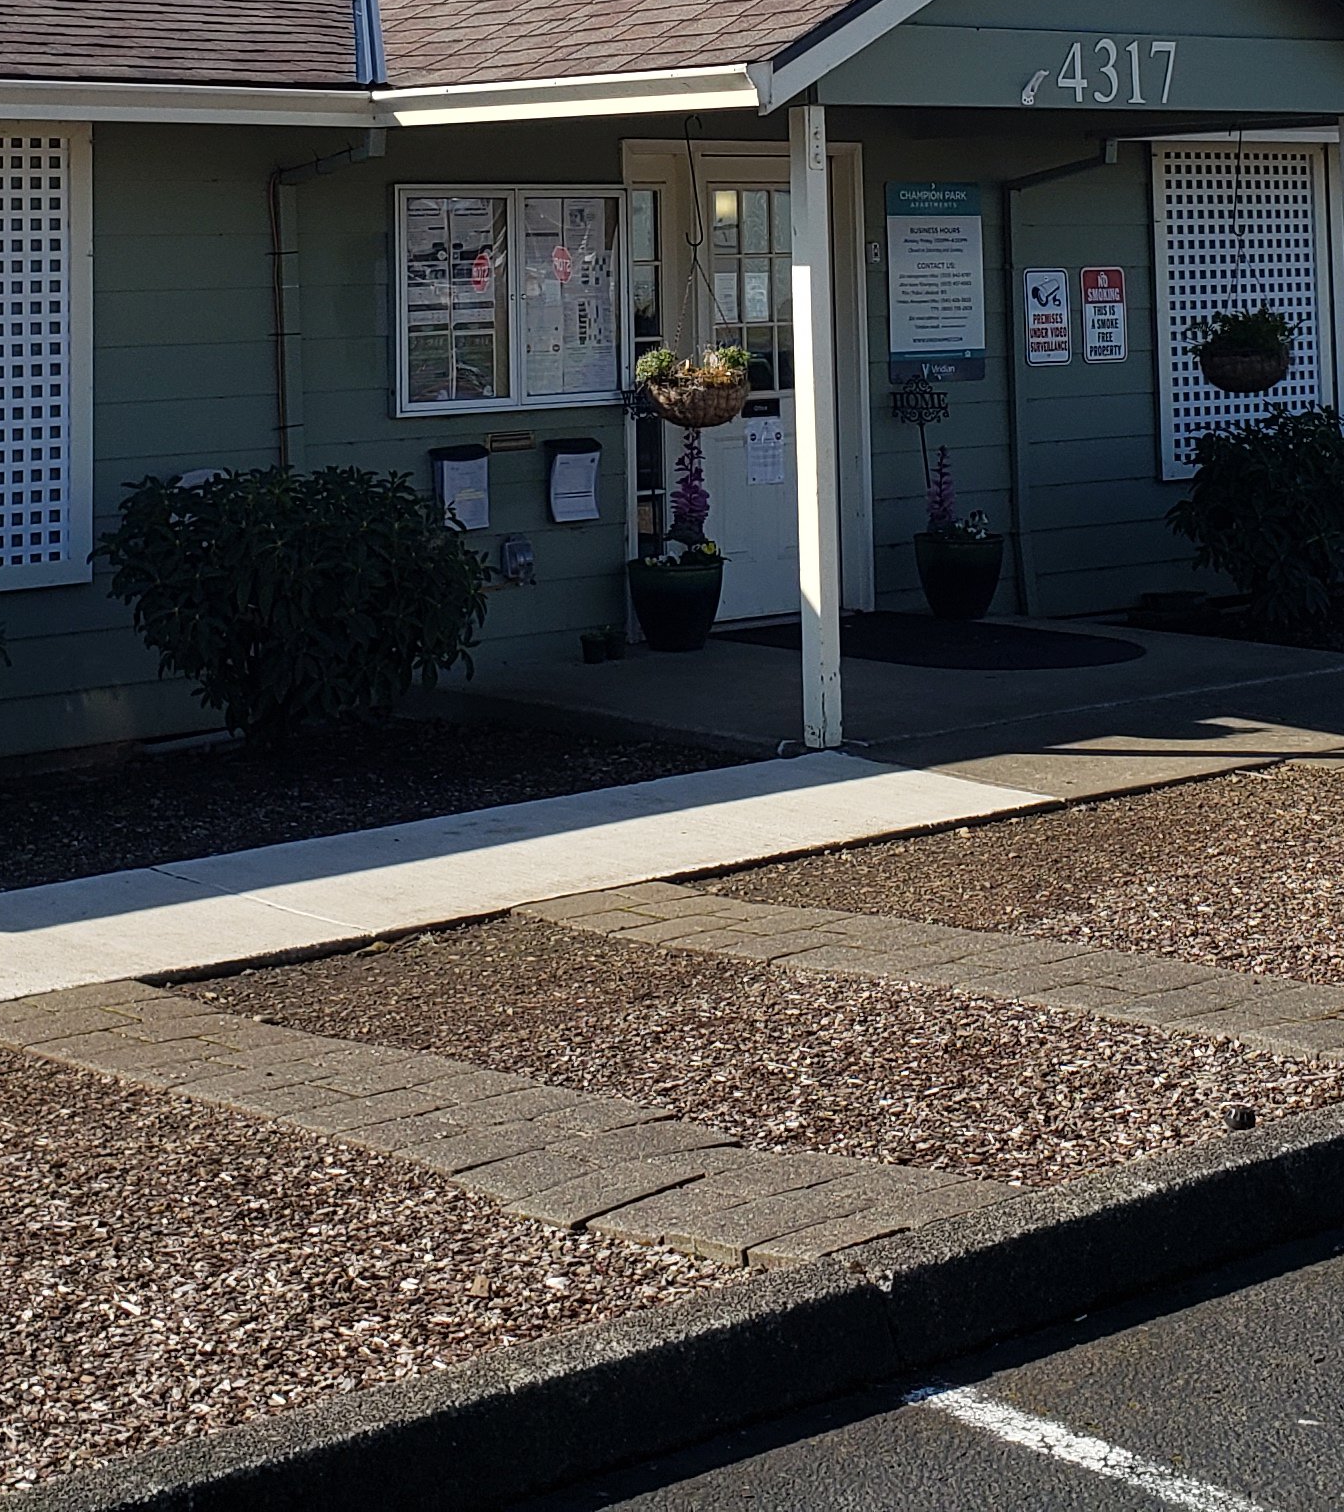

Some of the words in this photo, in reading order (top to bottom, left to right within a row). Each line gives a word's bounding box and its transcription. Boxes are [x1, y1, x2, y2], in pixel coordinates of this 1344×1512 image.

[1057, 38, 1177, 104] 4317
[899, 190, 943, 200] CHAMPION
[944, 191, 967, 200] PARK
[1097, 275, 1109, 287] NO
[1087, 288, 1120, 301] SMOKING
[1093, 305, 1107, 316] THIS
[1108, 305, 1116, 316] IS
[1032, 313, 1063, 325] PREMISES
[1091, 318, 1096, 329] A
[1096, 318, 1119, 329] SMOKE
[1030, 327, 1049, 338] UNDER
[1050, 326, 1067, 338] VIDEO
[1097, 331, 1113, 343] FREE
[1030, 340, 1068, 353] SURVEILLANCE
[1089, 345, 1122, 357] PROPERTY
[890, 392, 949, 409] HOME
